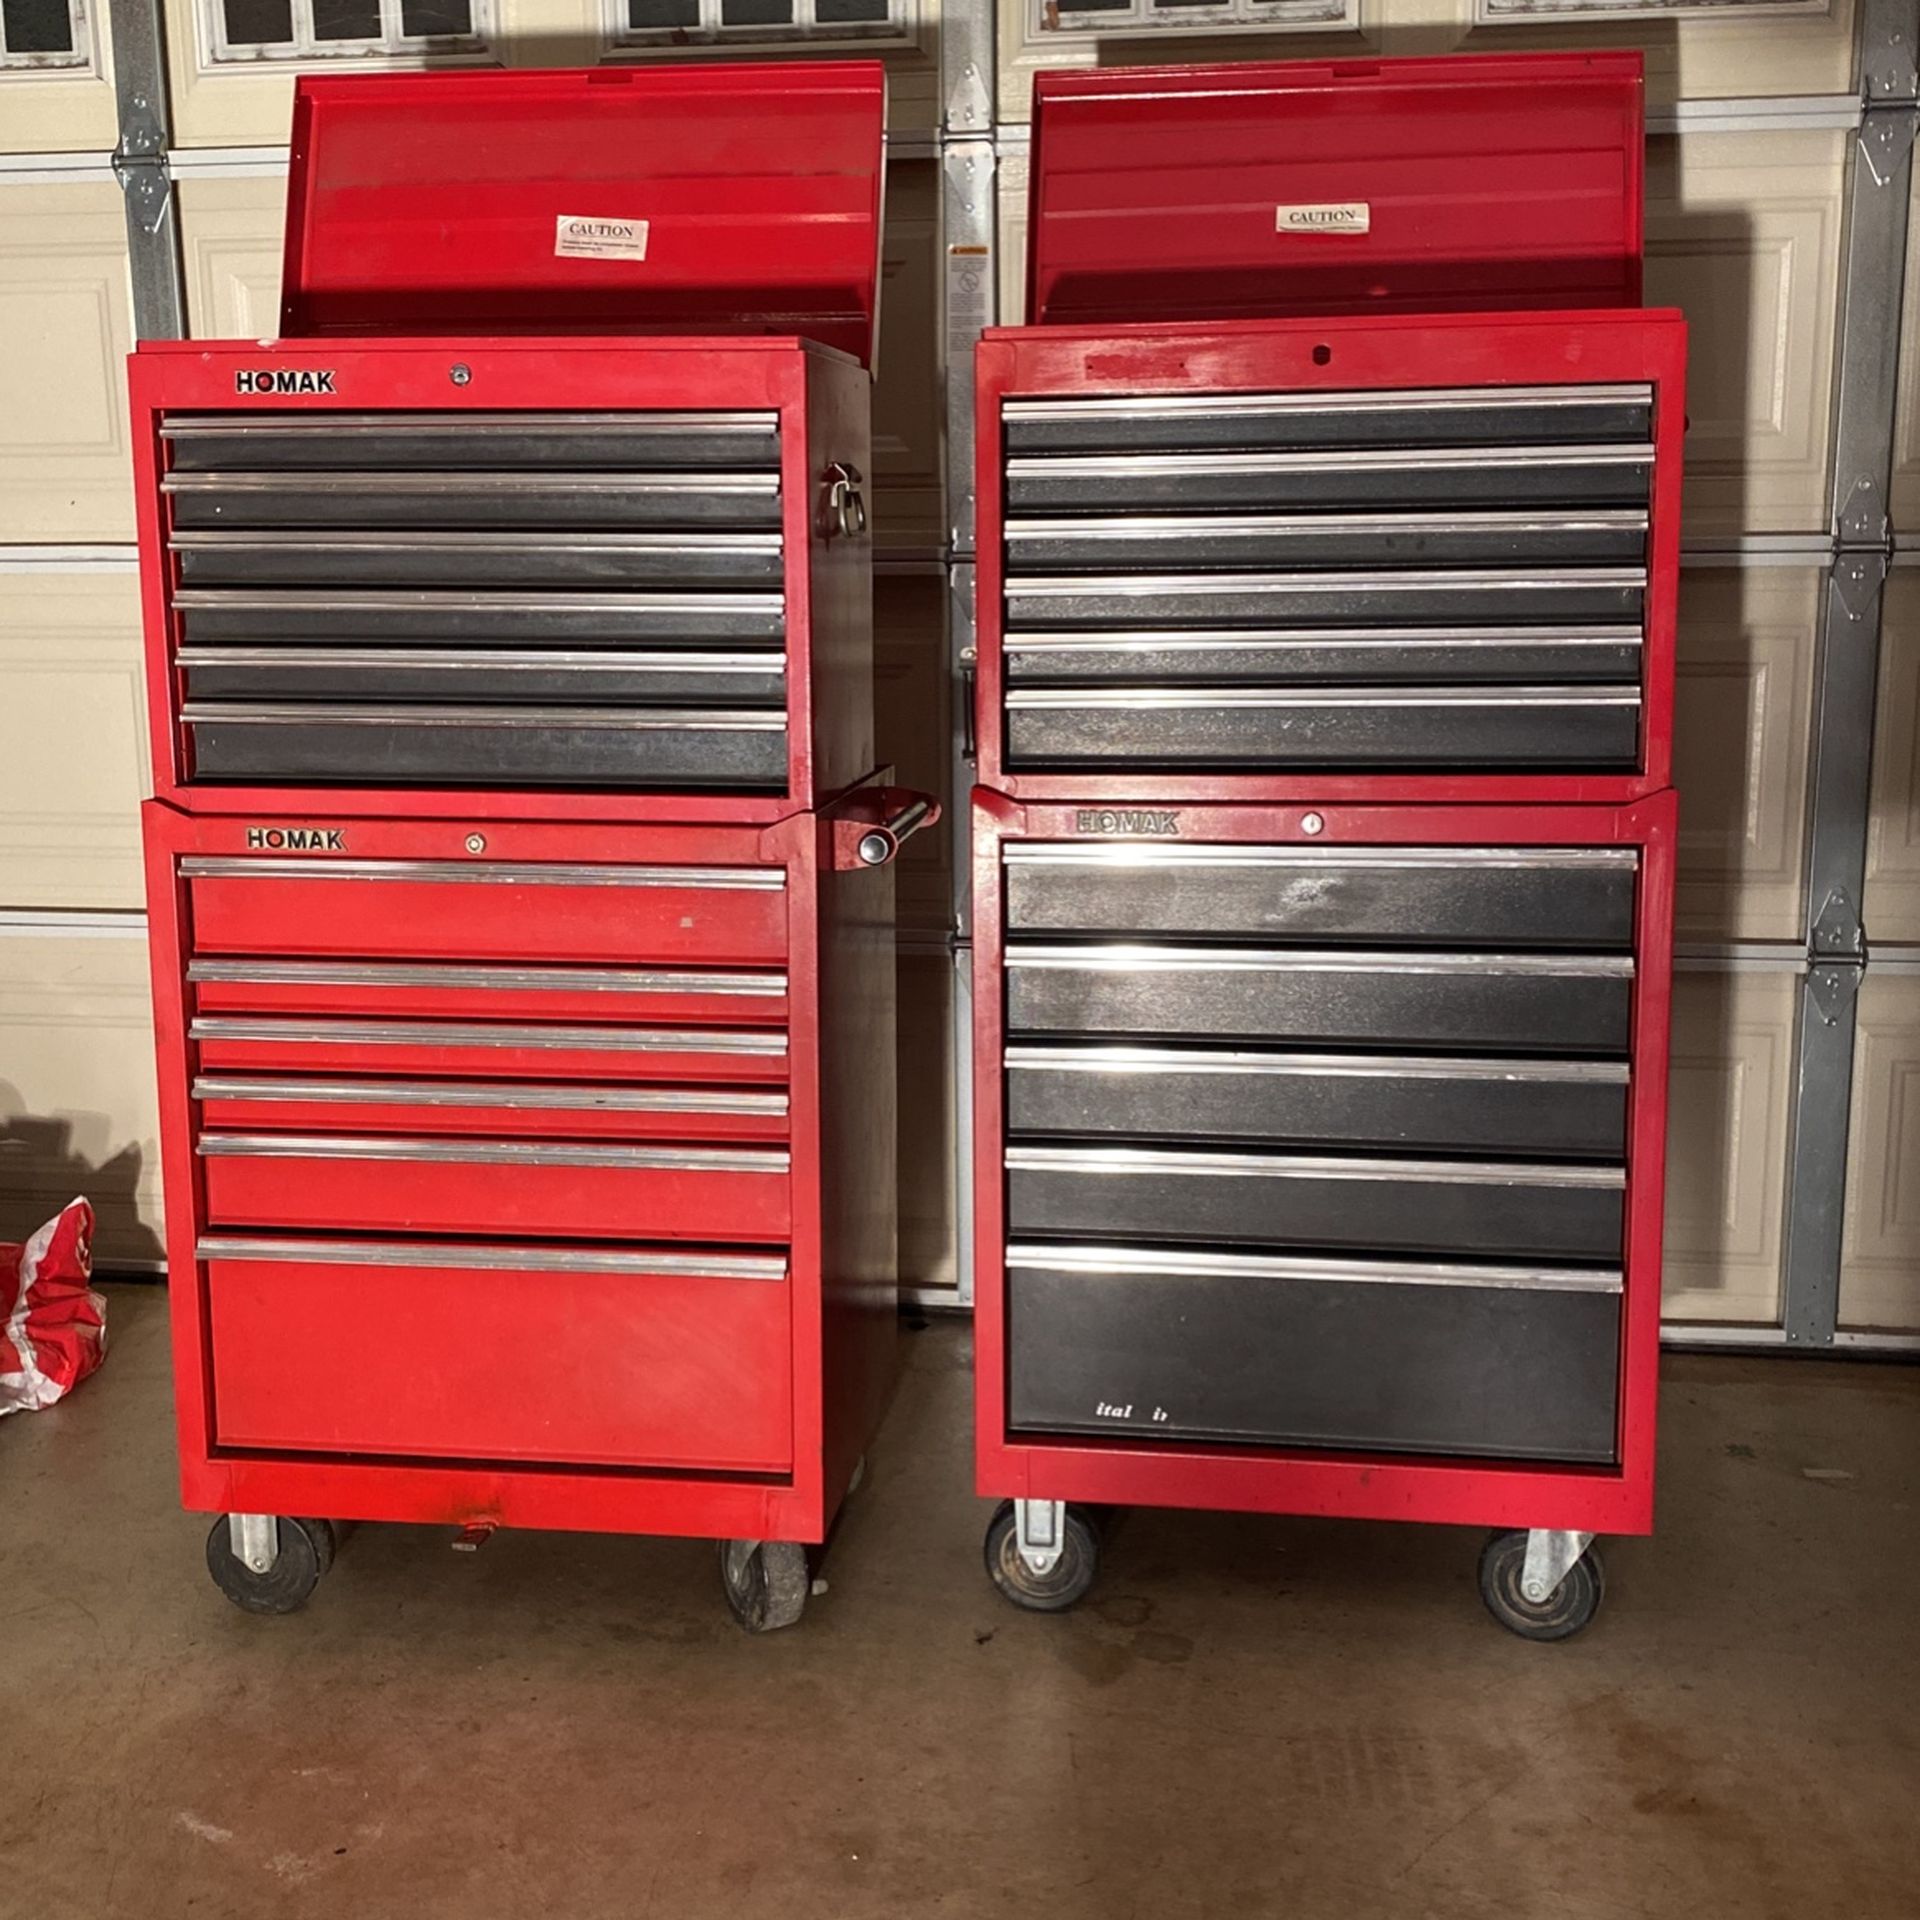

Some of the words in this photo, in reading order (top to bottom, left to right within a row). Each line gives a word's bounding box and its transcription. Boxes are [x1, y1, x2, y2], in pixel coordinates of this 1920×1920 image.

[1288, 209, 1356, 224] CAUTION
[568, 223, 634, 238] CAUTION
[235, 370, 336, 394] HOMAK
[1076, 809, 1180, 834] HOMAK
[246, 828, 345, 851] HOMAK
[1096, 1402, 1133, 1418] ital
